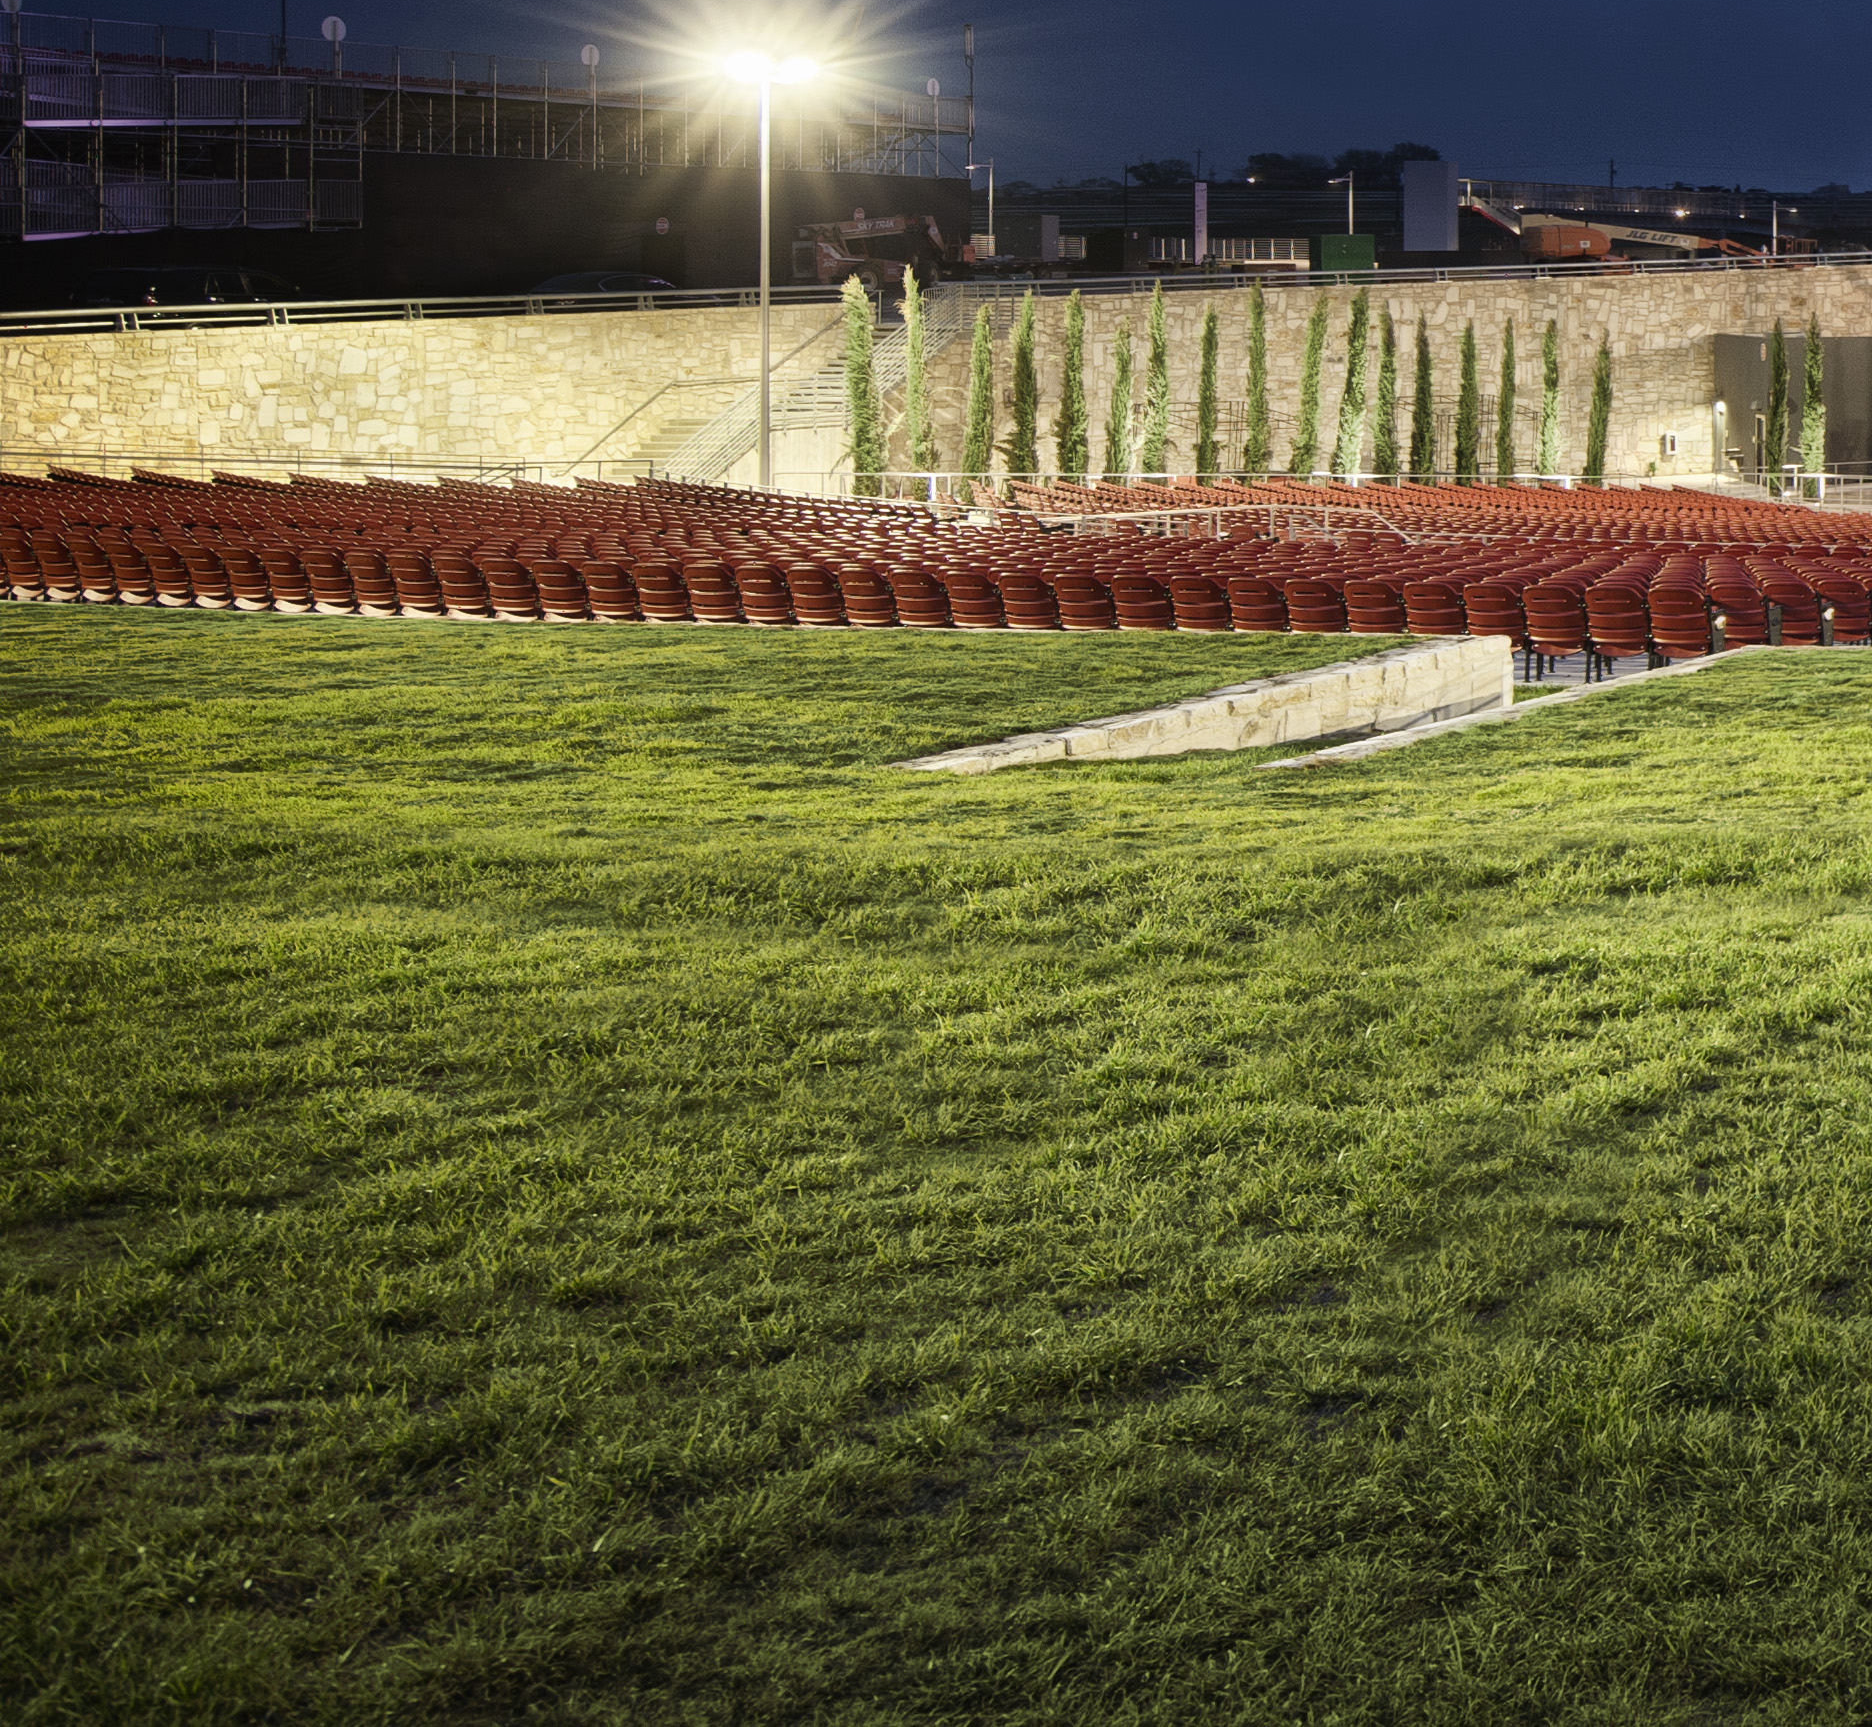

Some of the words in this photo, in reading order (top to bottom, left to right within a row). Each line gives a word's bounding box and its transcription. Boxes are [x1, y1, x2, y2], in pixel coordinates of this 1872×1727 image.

[857, 220, 874, 231] SKY
[874, 219, 896, 230] TRAK
[1625, 230, 1649, 240] JLG
[1650, 233, 1678, 243] LIFT
